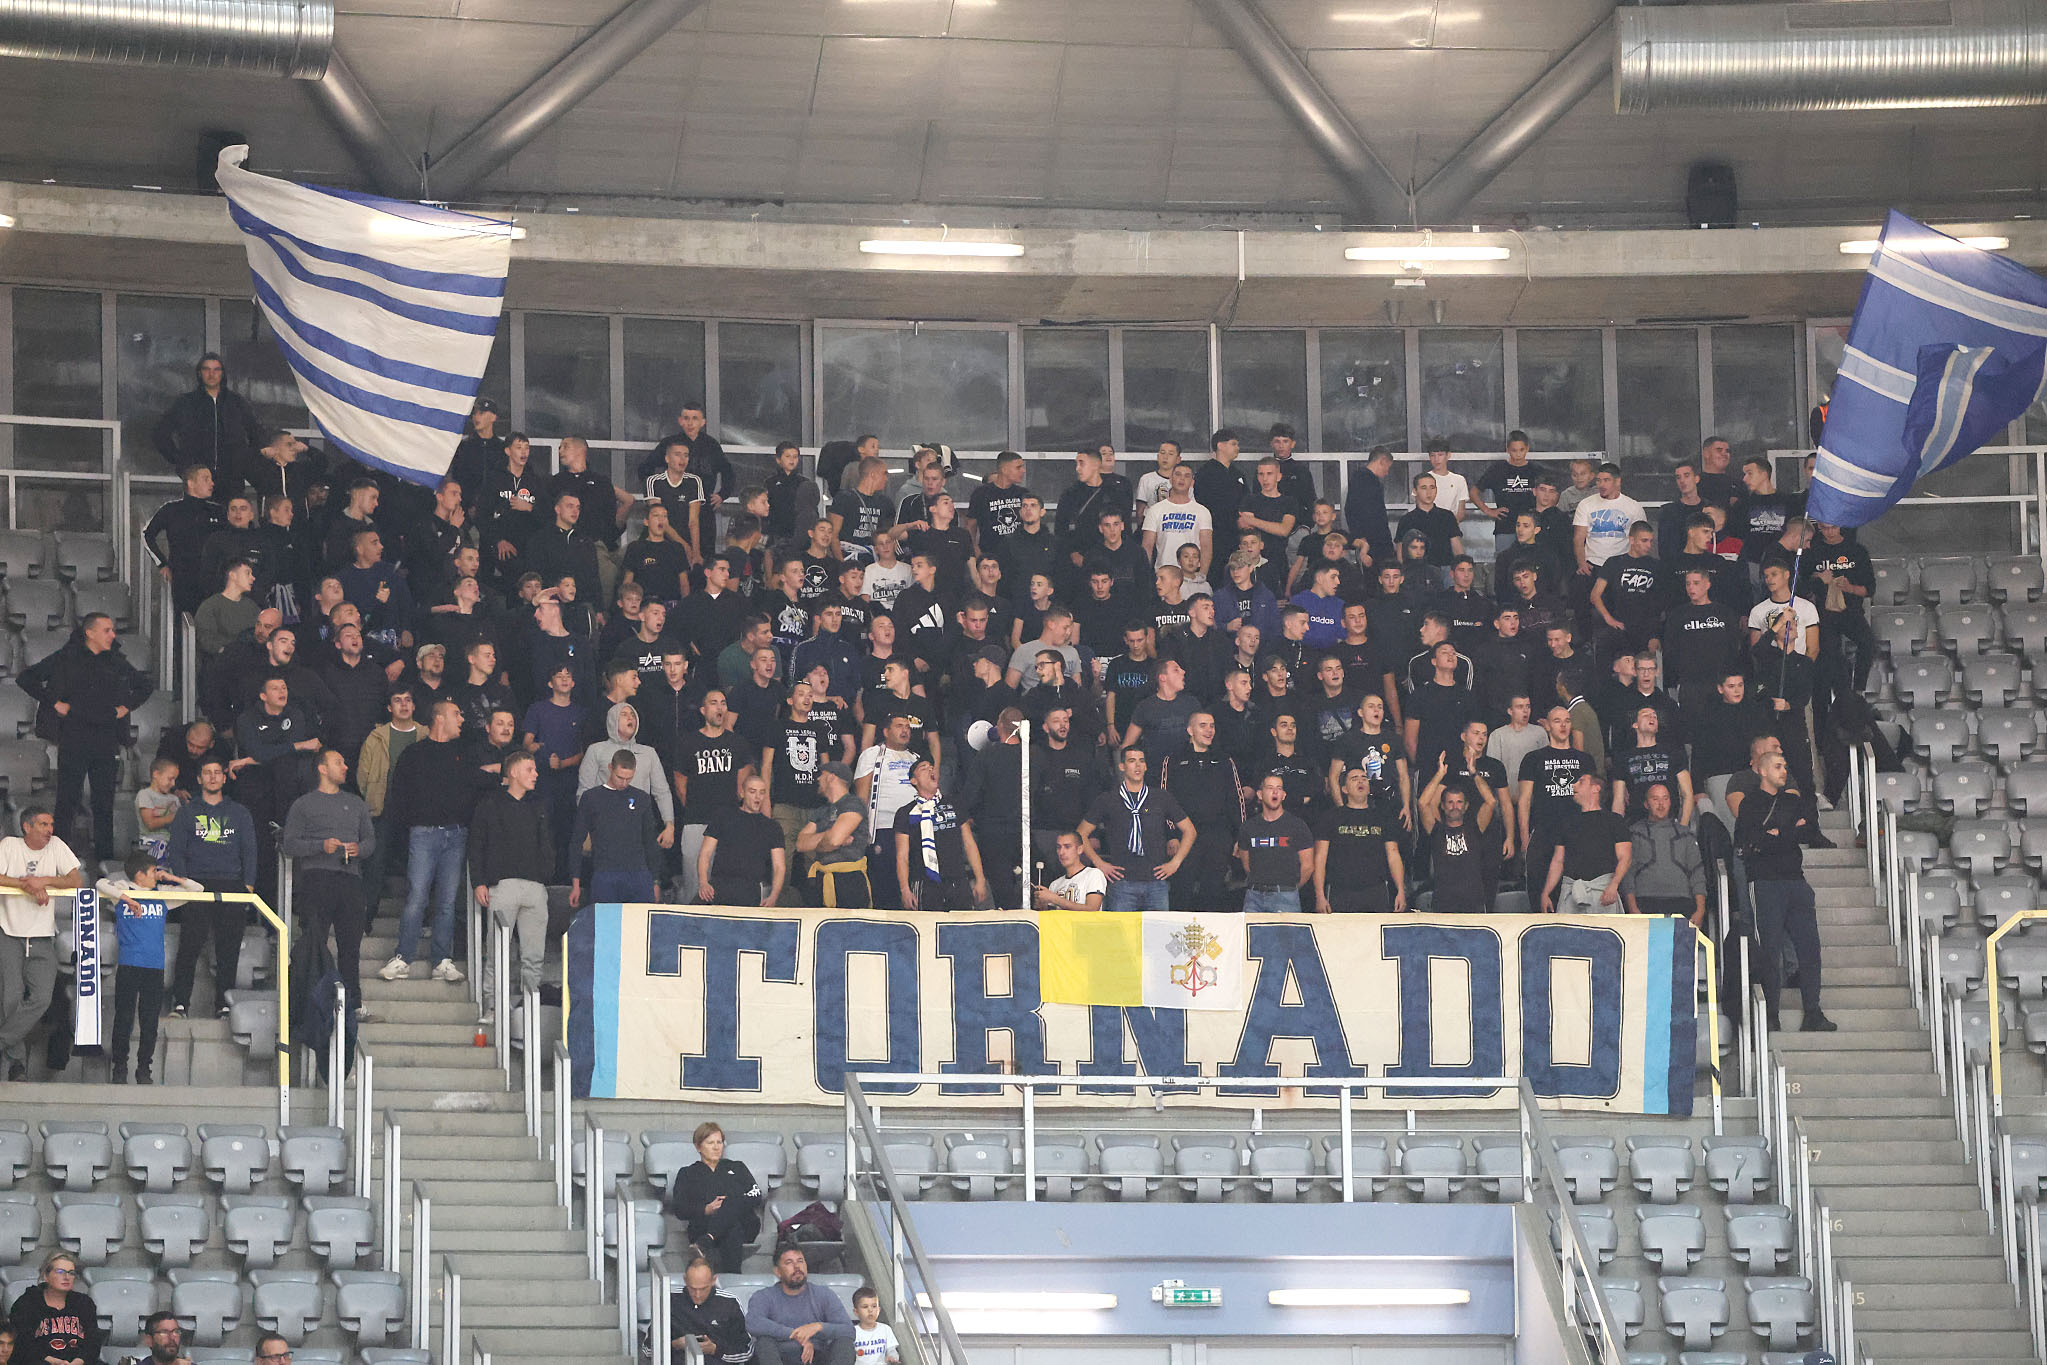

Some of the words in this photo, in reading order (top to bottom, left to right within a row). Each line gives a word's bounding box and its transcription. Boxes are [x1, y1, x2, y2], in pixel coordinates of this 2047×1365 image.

[1162, 512, 1196, 522] LUDACI
[1161, 521, 1195, 531] PRVACI
[1815, 560, 1856, 571] ellesse
[1155, 614, 1191, 628] TORCIDA
[1310, 615, 1335, 625] adidas
[1684, 620, 1726, 631] ellesse
[697, 756, 733, 775] BANJ
[79, 889, 96, 997] ORNADO
[1785, 1082, 1801, 1095] 18
[1807, 1149, 1822, 1163] 17
